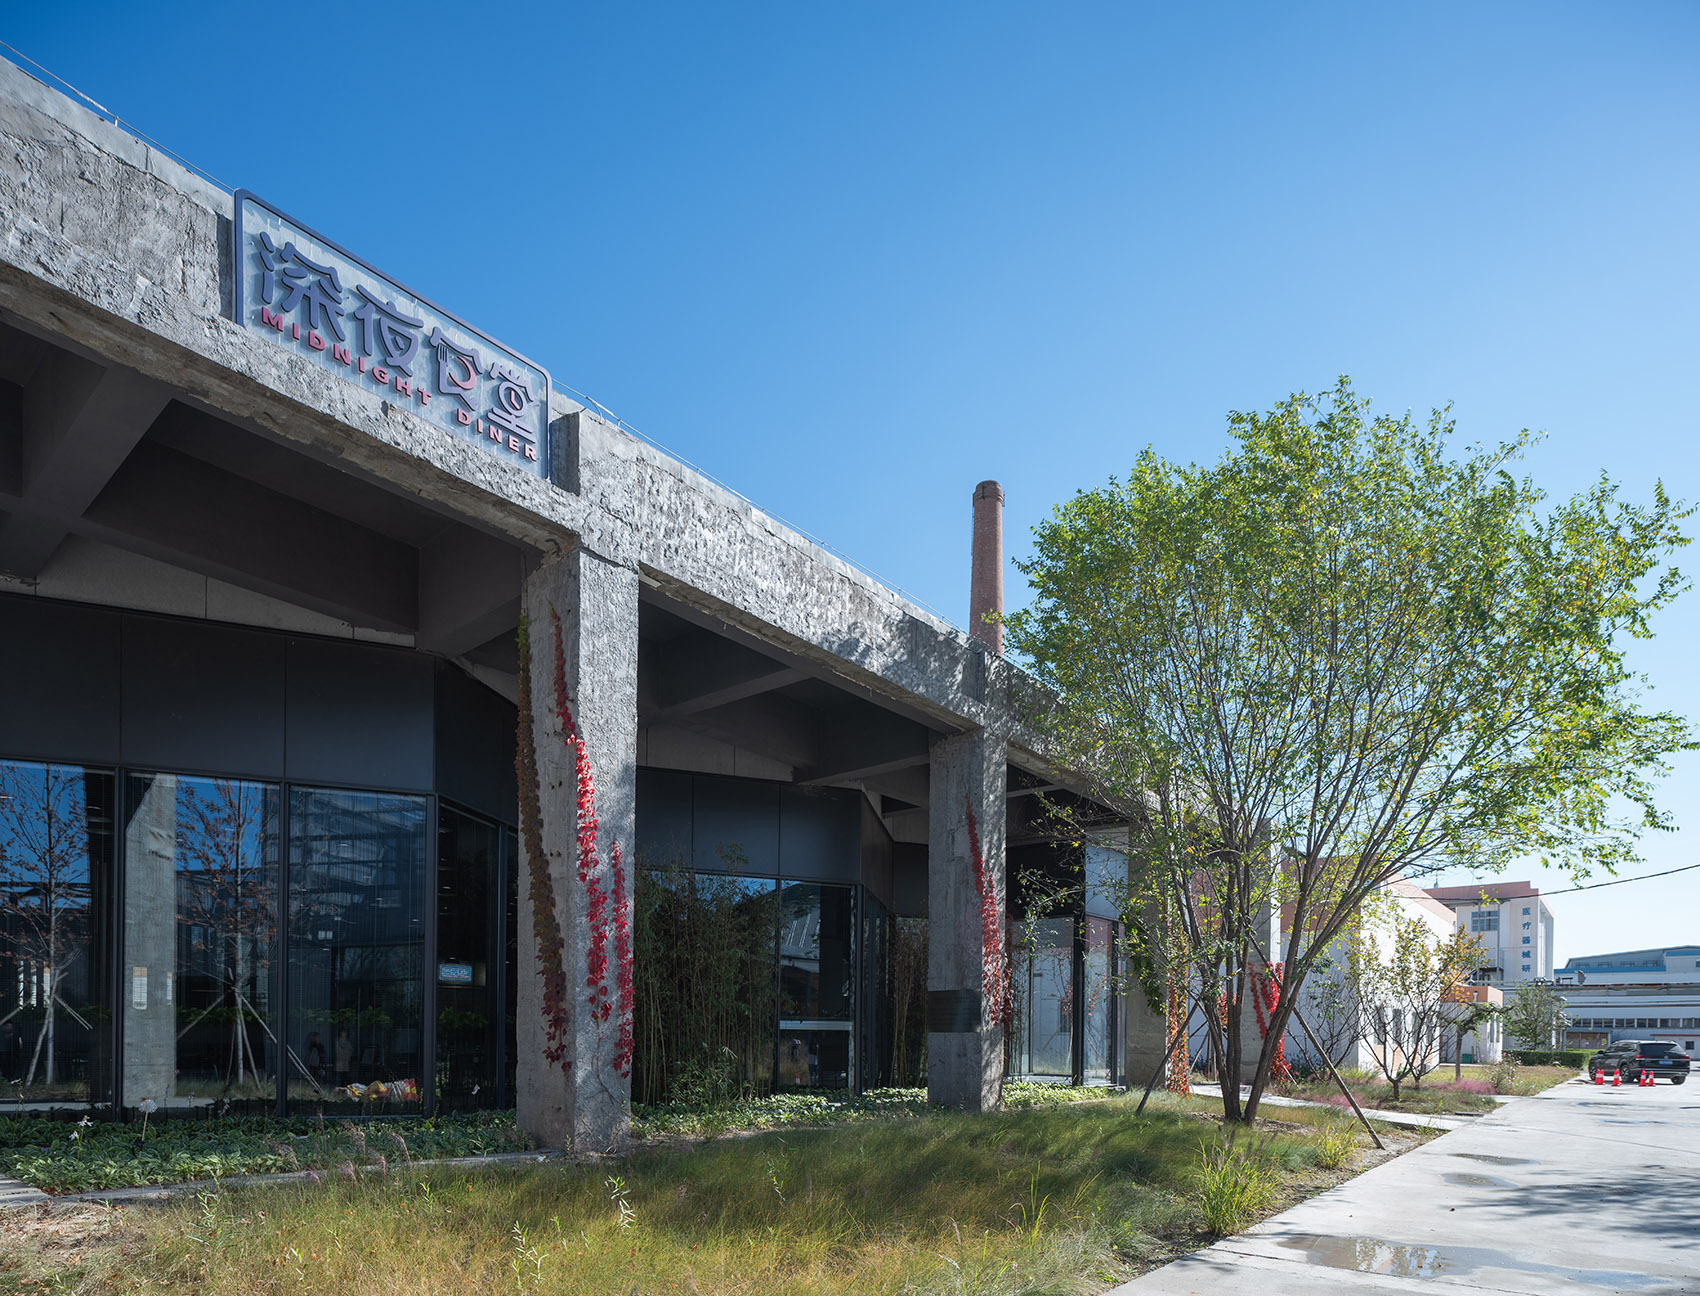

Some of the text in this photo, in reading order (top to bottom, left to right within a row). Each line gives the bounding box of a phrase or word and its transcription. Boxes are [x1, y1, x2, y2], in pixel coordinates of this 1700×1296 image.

[259, 232, 536, 443] 深夜食堂
[262, 307, 537, 462] MIDNIGHT DINER
[1521, 907, 1531, 980] 医疗器械研
